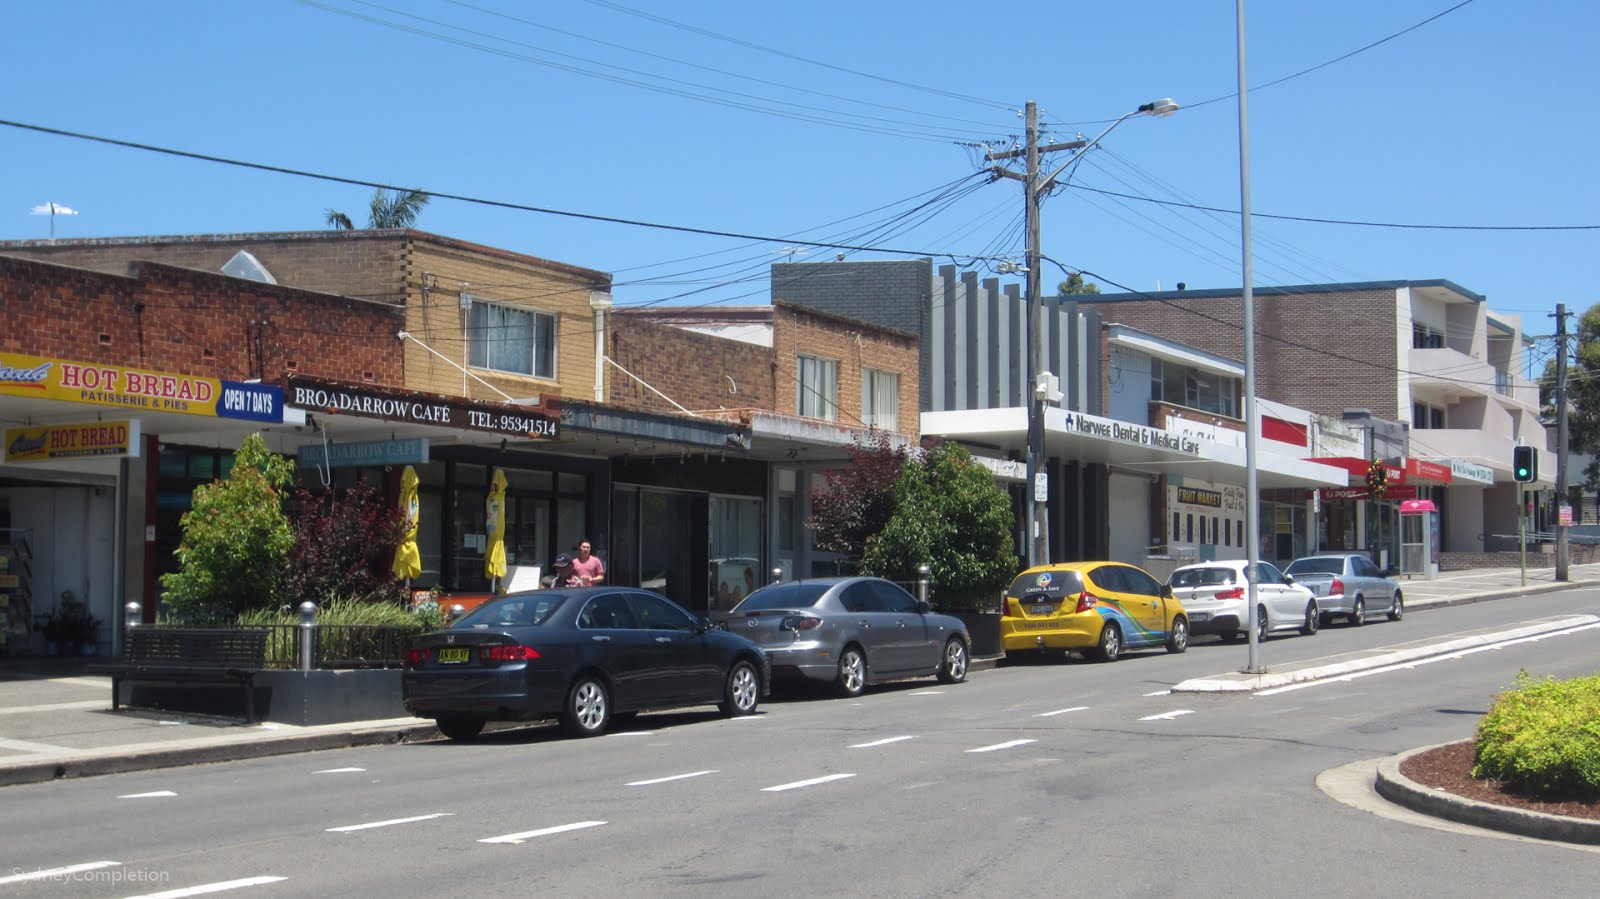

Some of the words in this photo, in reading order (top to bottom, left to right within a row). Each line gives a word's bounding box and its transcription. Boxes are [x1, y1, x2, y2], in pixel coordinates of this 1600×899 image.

[61, 364, 118, 391] HOT
[125, 372, 213, 401] BREAD
[81, 390, 148, 406] PATISSERIE
[152, 399, 160, 408] &
[164, 400, 188, 411] PIES
[224, 388, 245, 411] OPEN
[246, 392, 251, 412] 7
[252, 391, 273, 414] DAYS
[294, 387, 410, 418] BROADARROW
[411, 404, 451, 423] CAFÉ
[468, 410, 498, 429] TEL:
[500, 415, 556, 436] 95341514
[51, 429, 78, 449] HOT
[81, 425, 126, 447] BREAD
[1113, 423, 1140, 442] Dental
[1141, 428, 1148, 444] &
[1150, 430, 1180, 450] Medical
[1181, 437, 1200, 454] Care
[302, 443, 385, 460] BROADARROW
[1179, 489, 1196, 502] FRUIT
[1197, 491, 1221, 507] MARKET
[1335, 490, 1357, 498] POST
